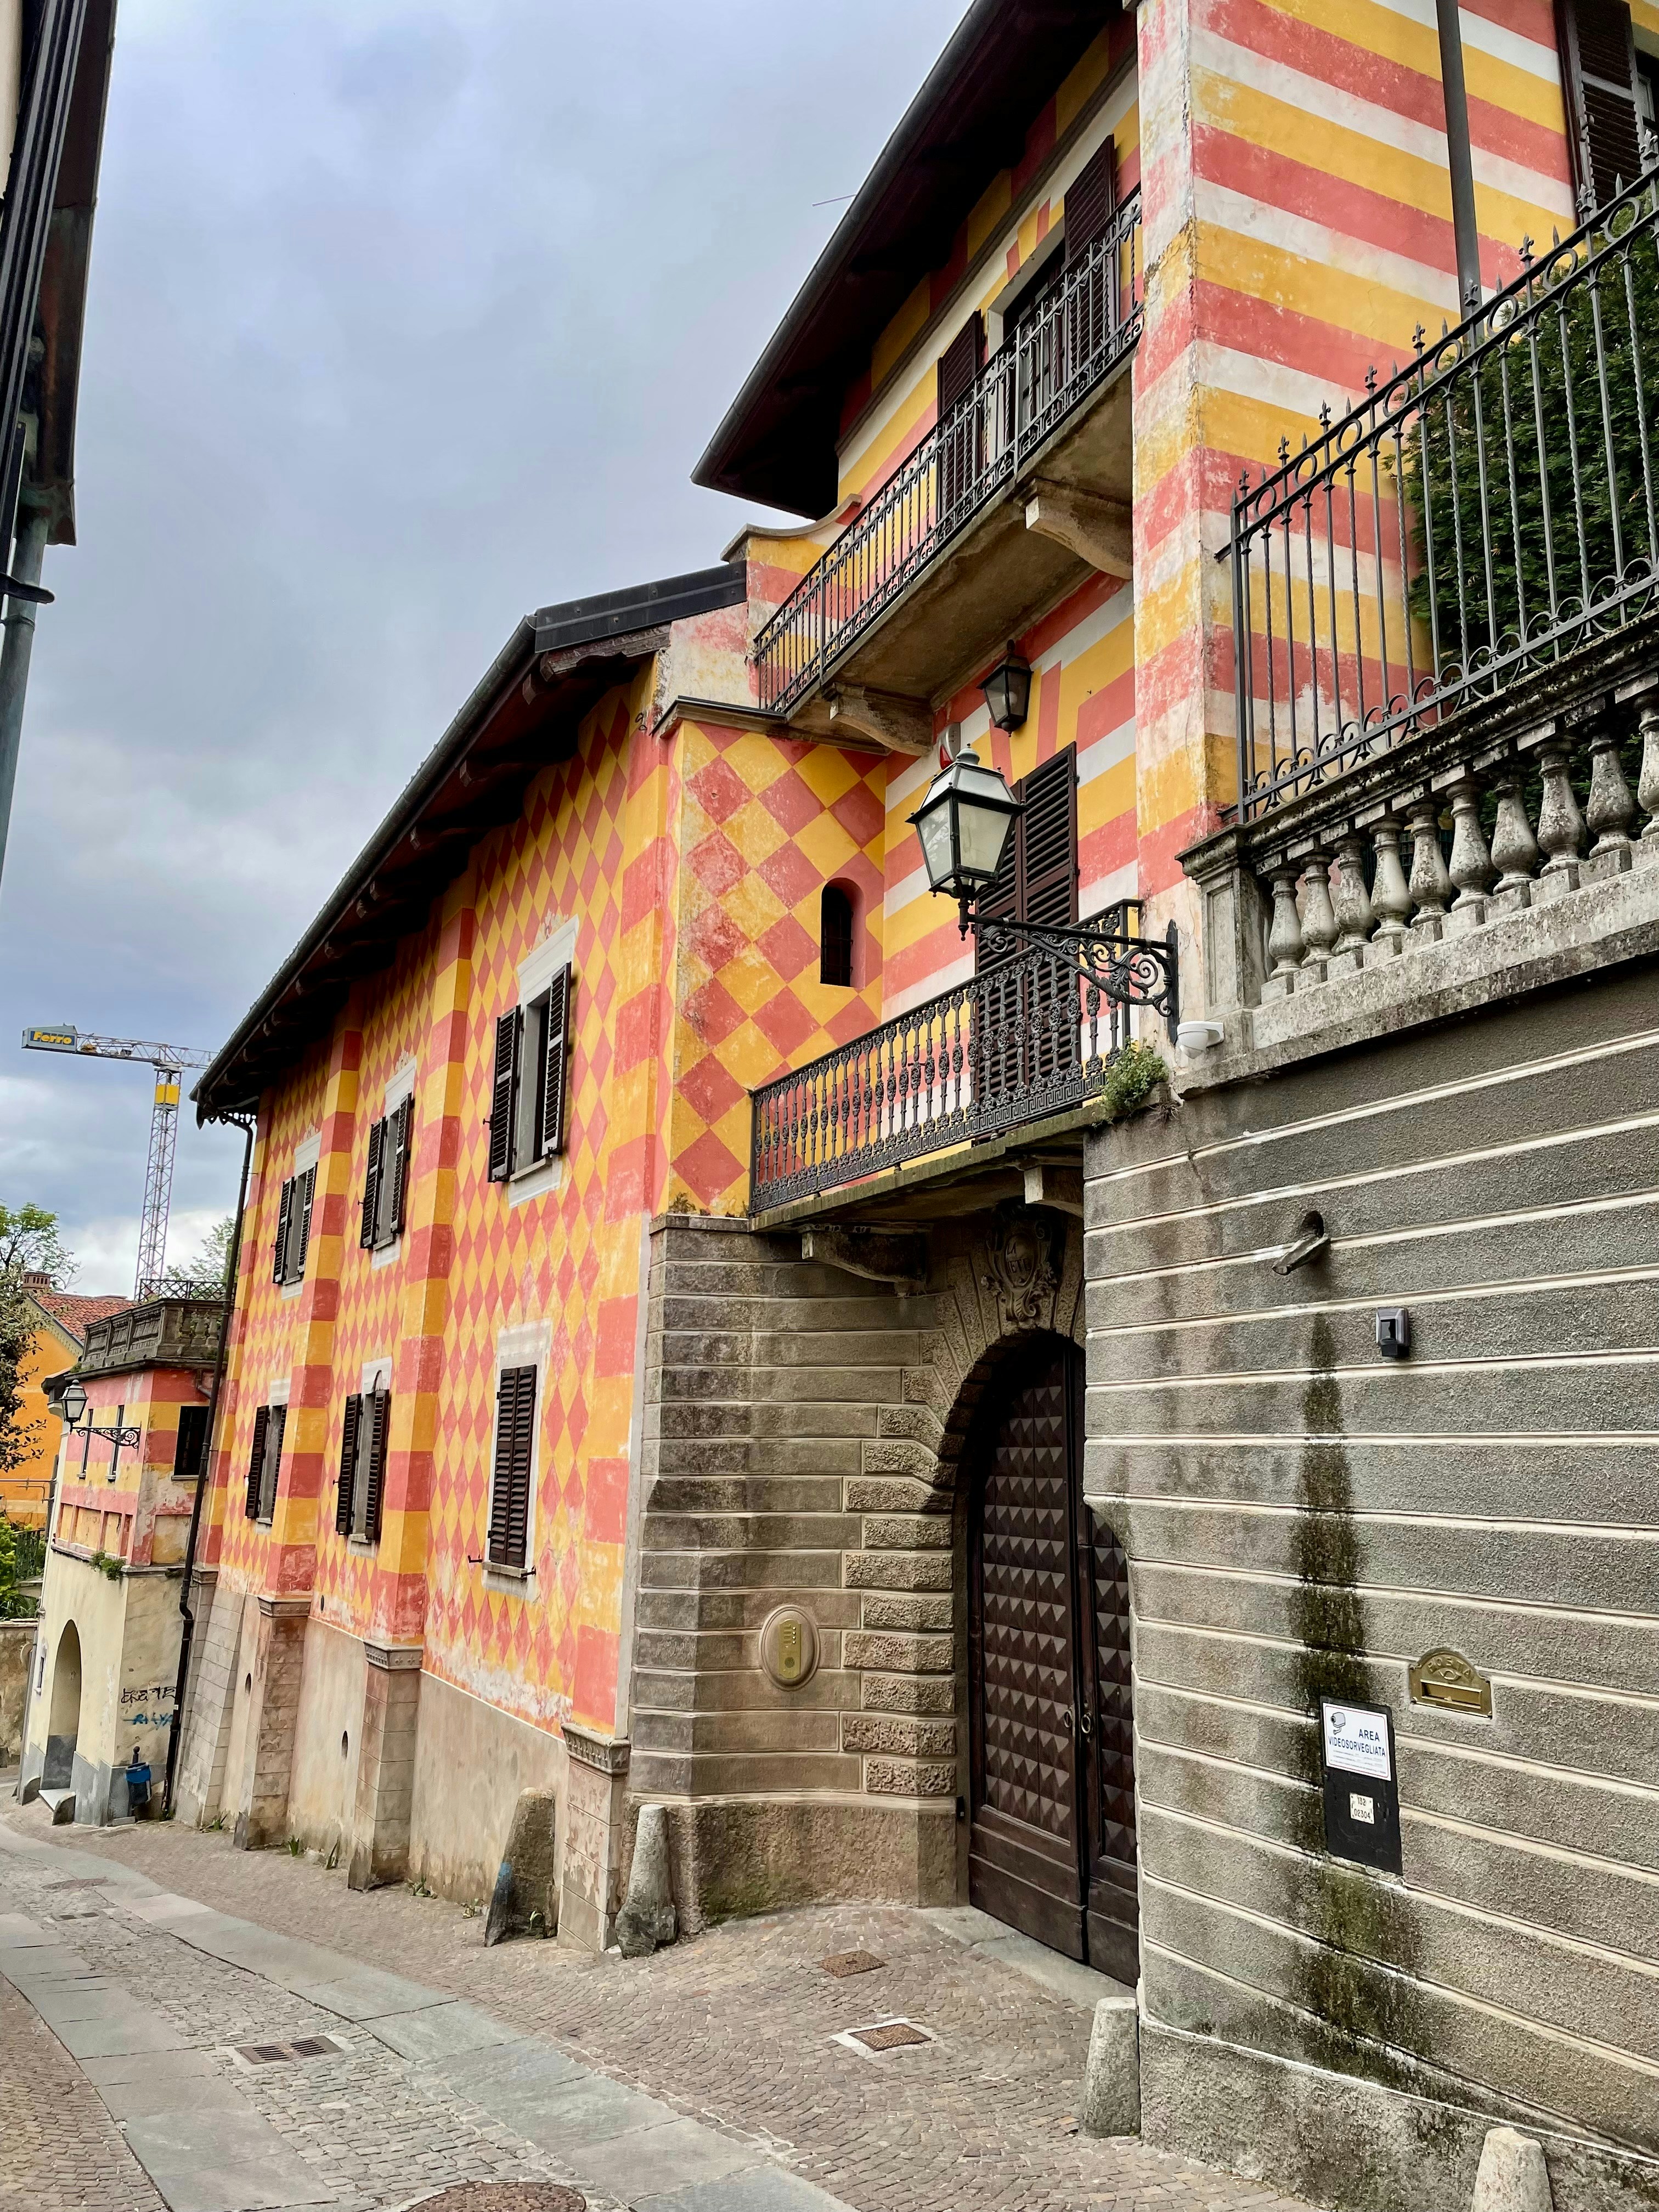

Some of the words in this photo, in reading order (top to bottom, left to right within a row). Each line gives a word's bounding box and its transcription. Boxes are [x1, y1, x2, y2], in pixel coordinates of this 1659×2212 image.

[33, 1031, 72, 1045] Ferro
[1427, 1656, 1474, 1683] POSTA
[1358, 1729, 1380, 1742] AREA
[1328, 1735, 1385, 1757] VIDEOSORVEGLIATA
[1357, 1796, 1366, 1806] 132
[1354, 1808, 1371, 1819] 02304
